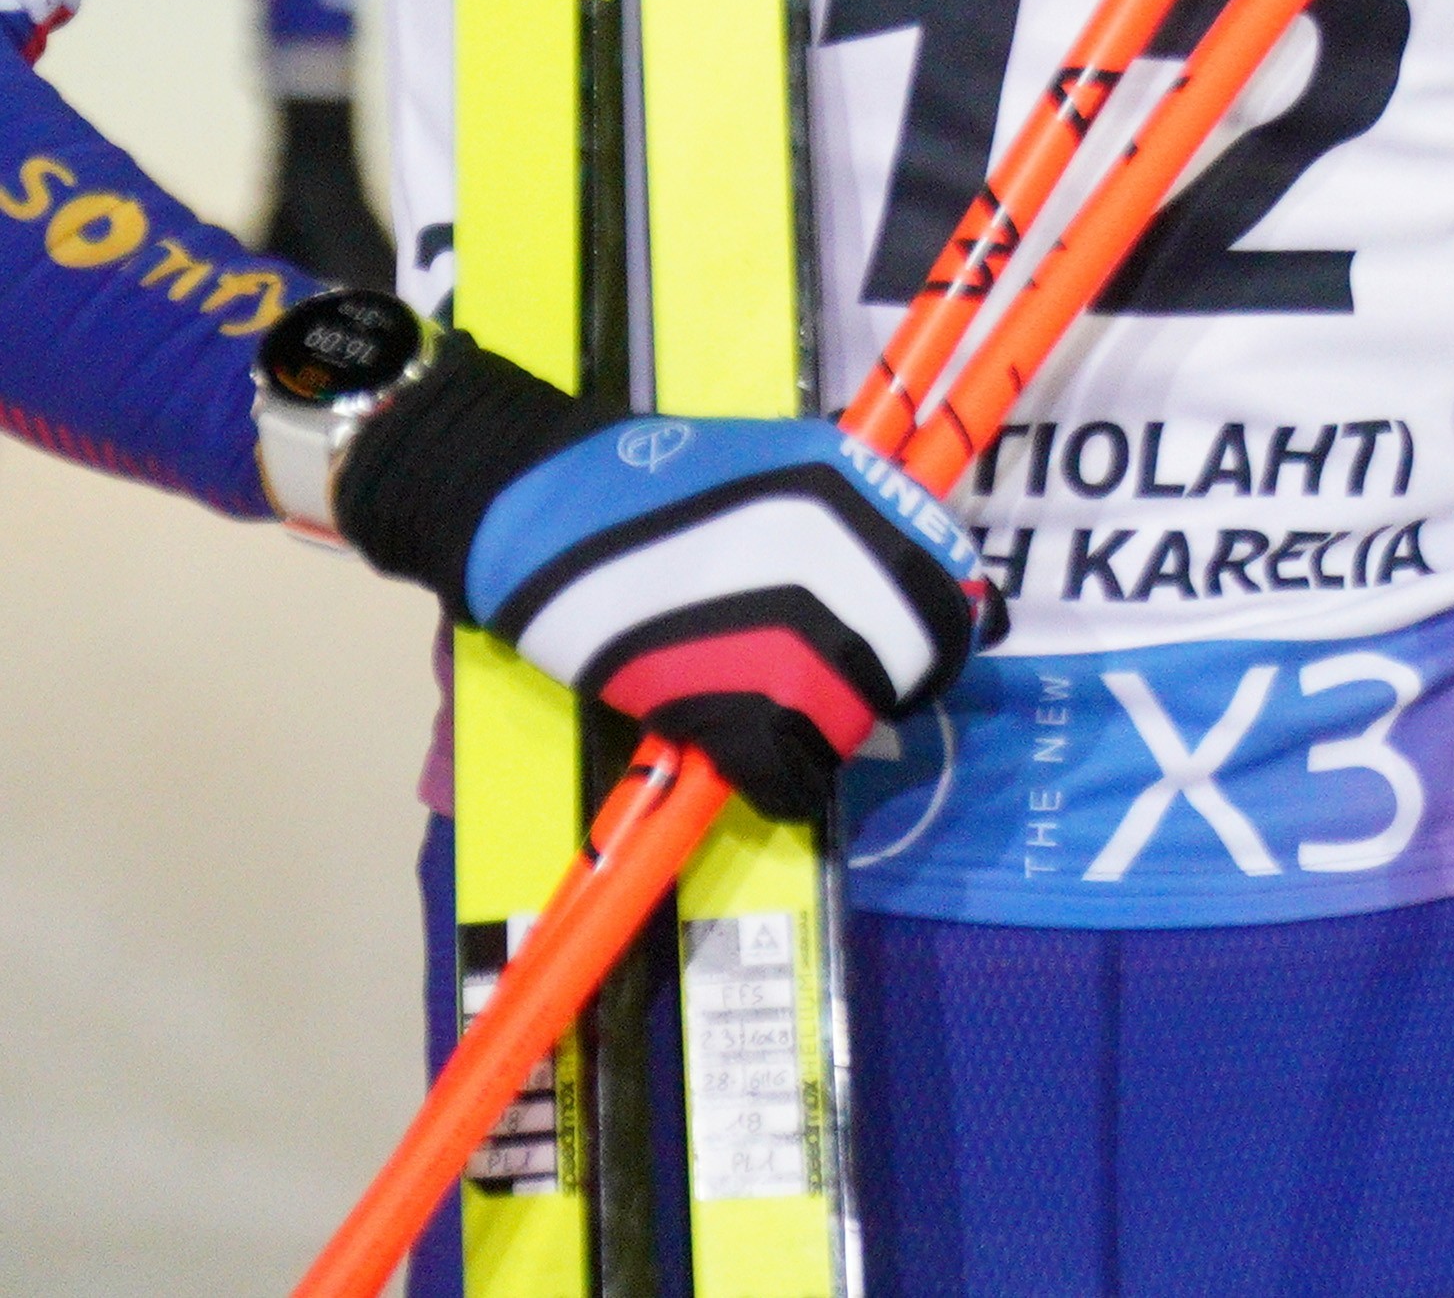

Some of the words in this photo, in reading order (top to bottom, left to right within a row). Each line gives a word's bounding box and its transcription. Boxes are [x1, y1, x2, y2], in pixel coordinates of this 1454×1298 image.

[975, 419, 1415, 500] TIOLAHTI
[1063, 520, 1437, 602] KARELIA
[1033, 672, 1072, 765] NEW
[1080, 649, 1427, 884] X3
[1024, 789, 1062, 880] THE
